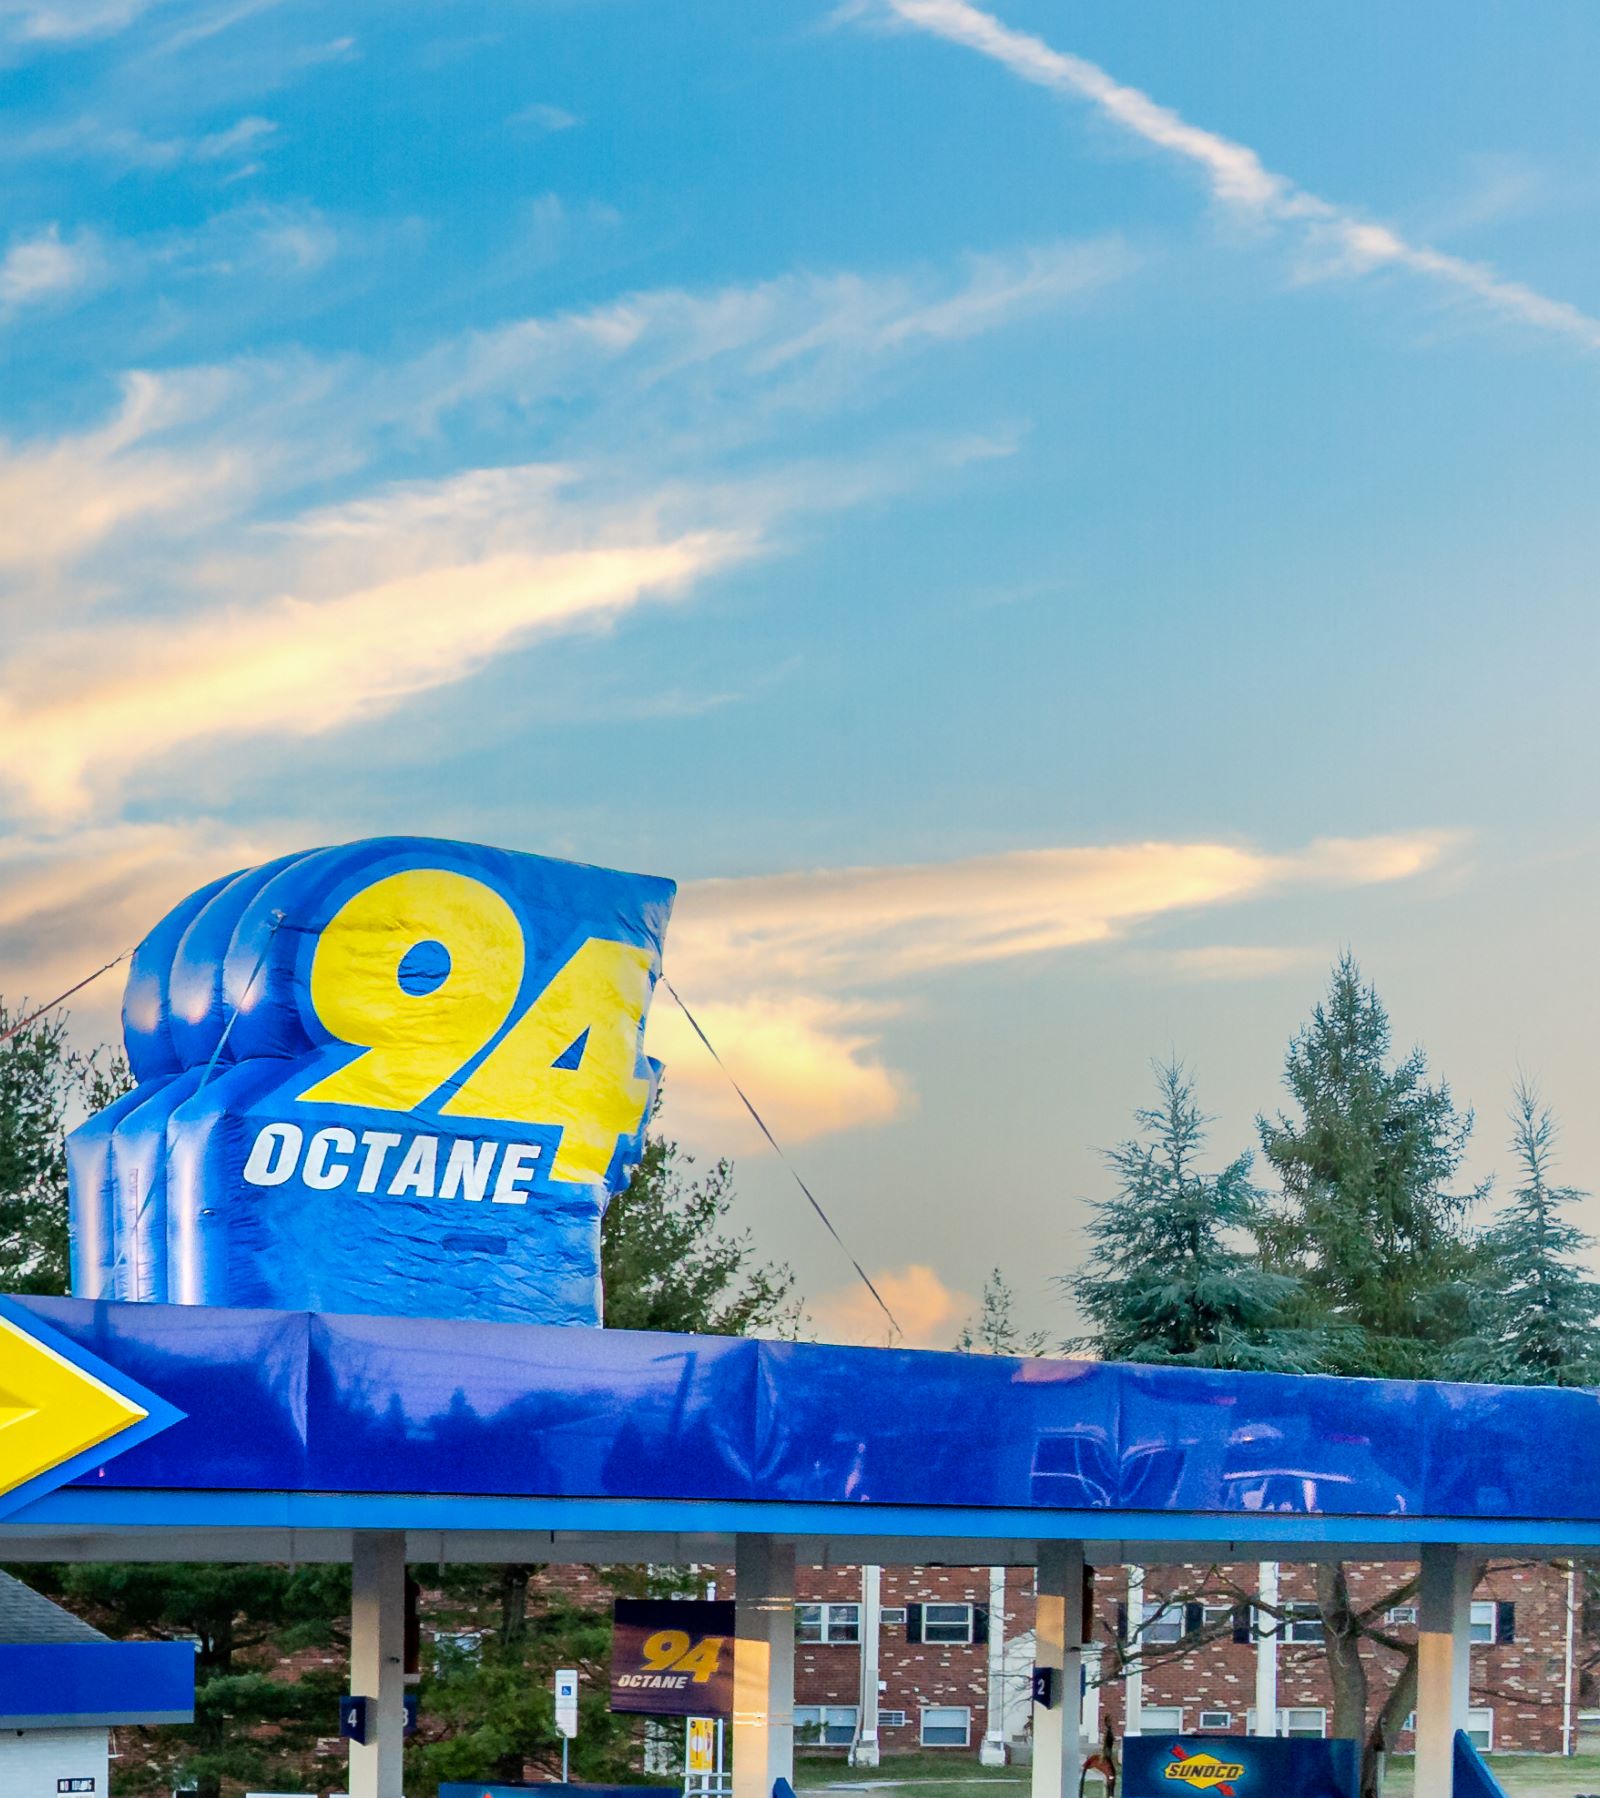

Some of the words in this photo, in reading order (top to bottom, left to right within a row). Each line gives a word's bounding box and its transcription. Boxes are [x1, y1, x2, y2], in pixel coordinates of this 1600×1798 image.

[296, 868, 655, 1185] 94
[243, 1122, 542, 1205] OCTANE
[640, 1629, 724, 1683] 94
[618, 1674, 688, 1689] OCTANE
[1037, 1678, 1045, 1695] 2
[347, 1708, 358, 1728] 4
[1168, 1764, 1242, 1779] SUNOCO
